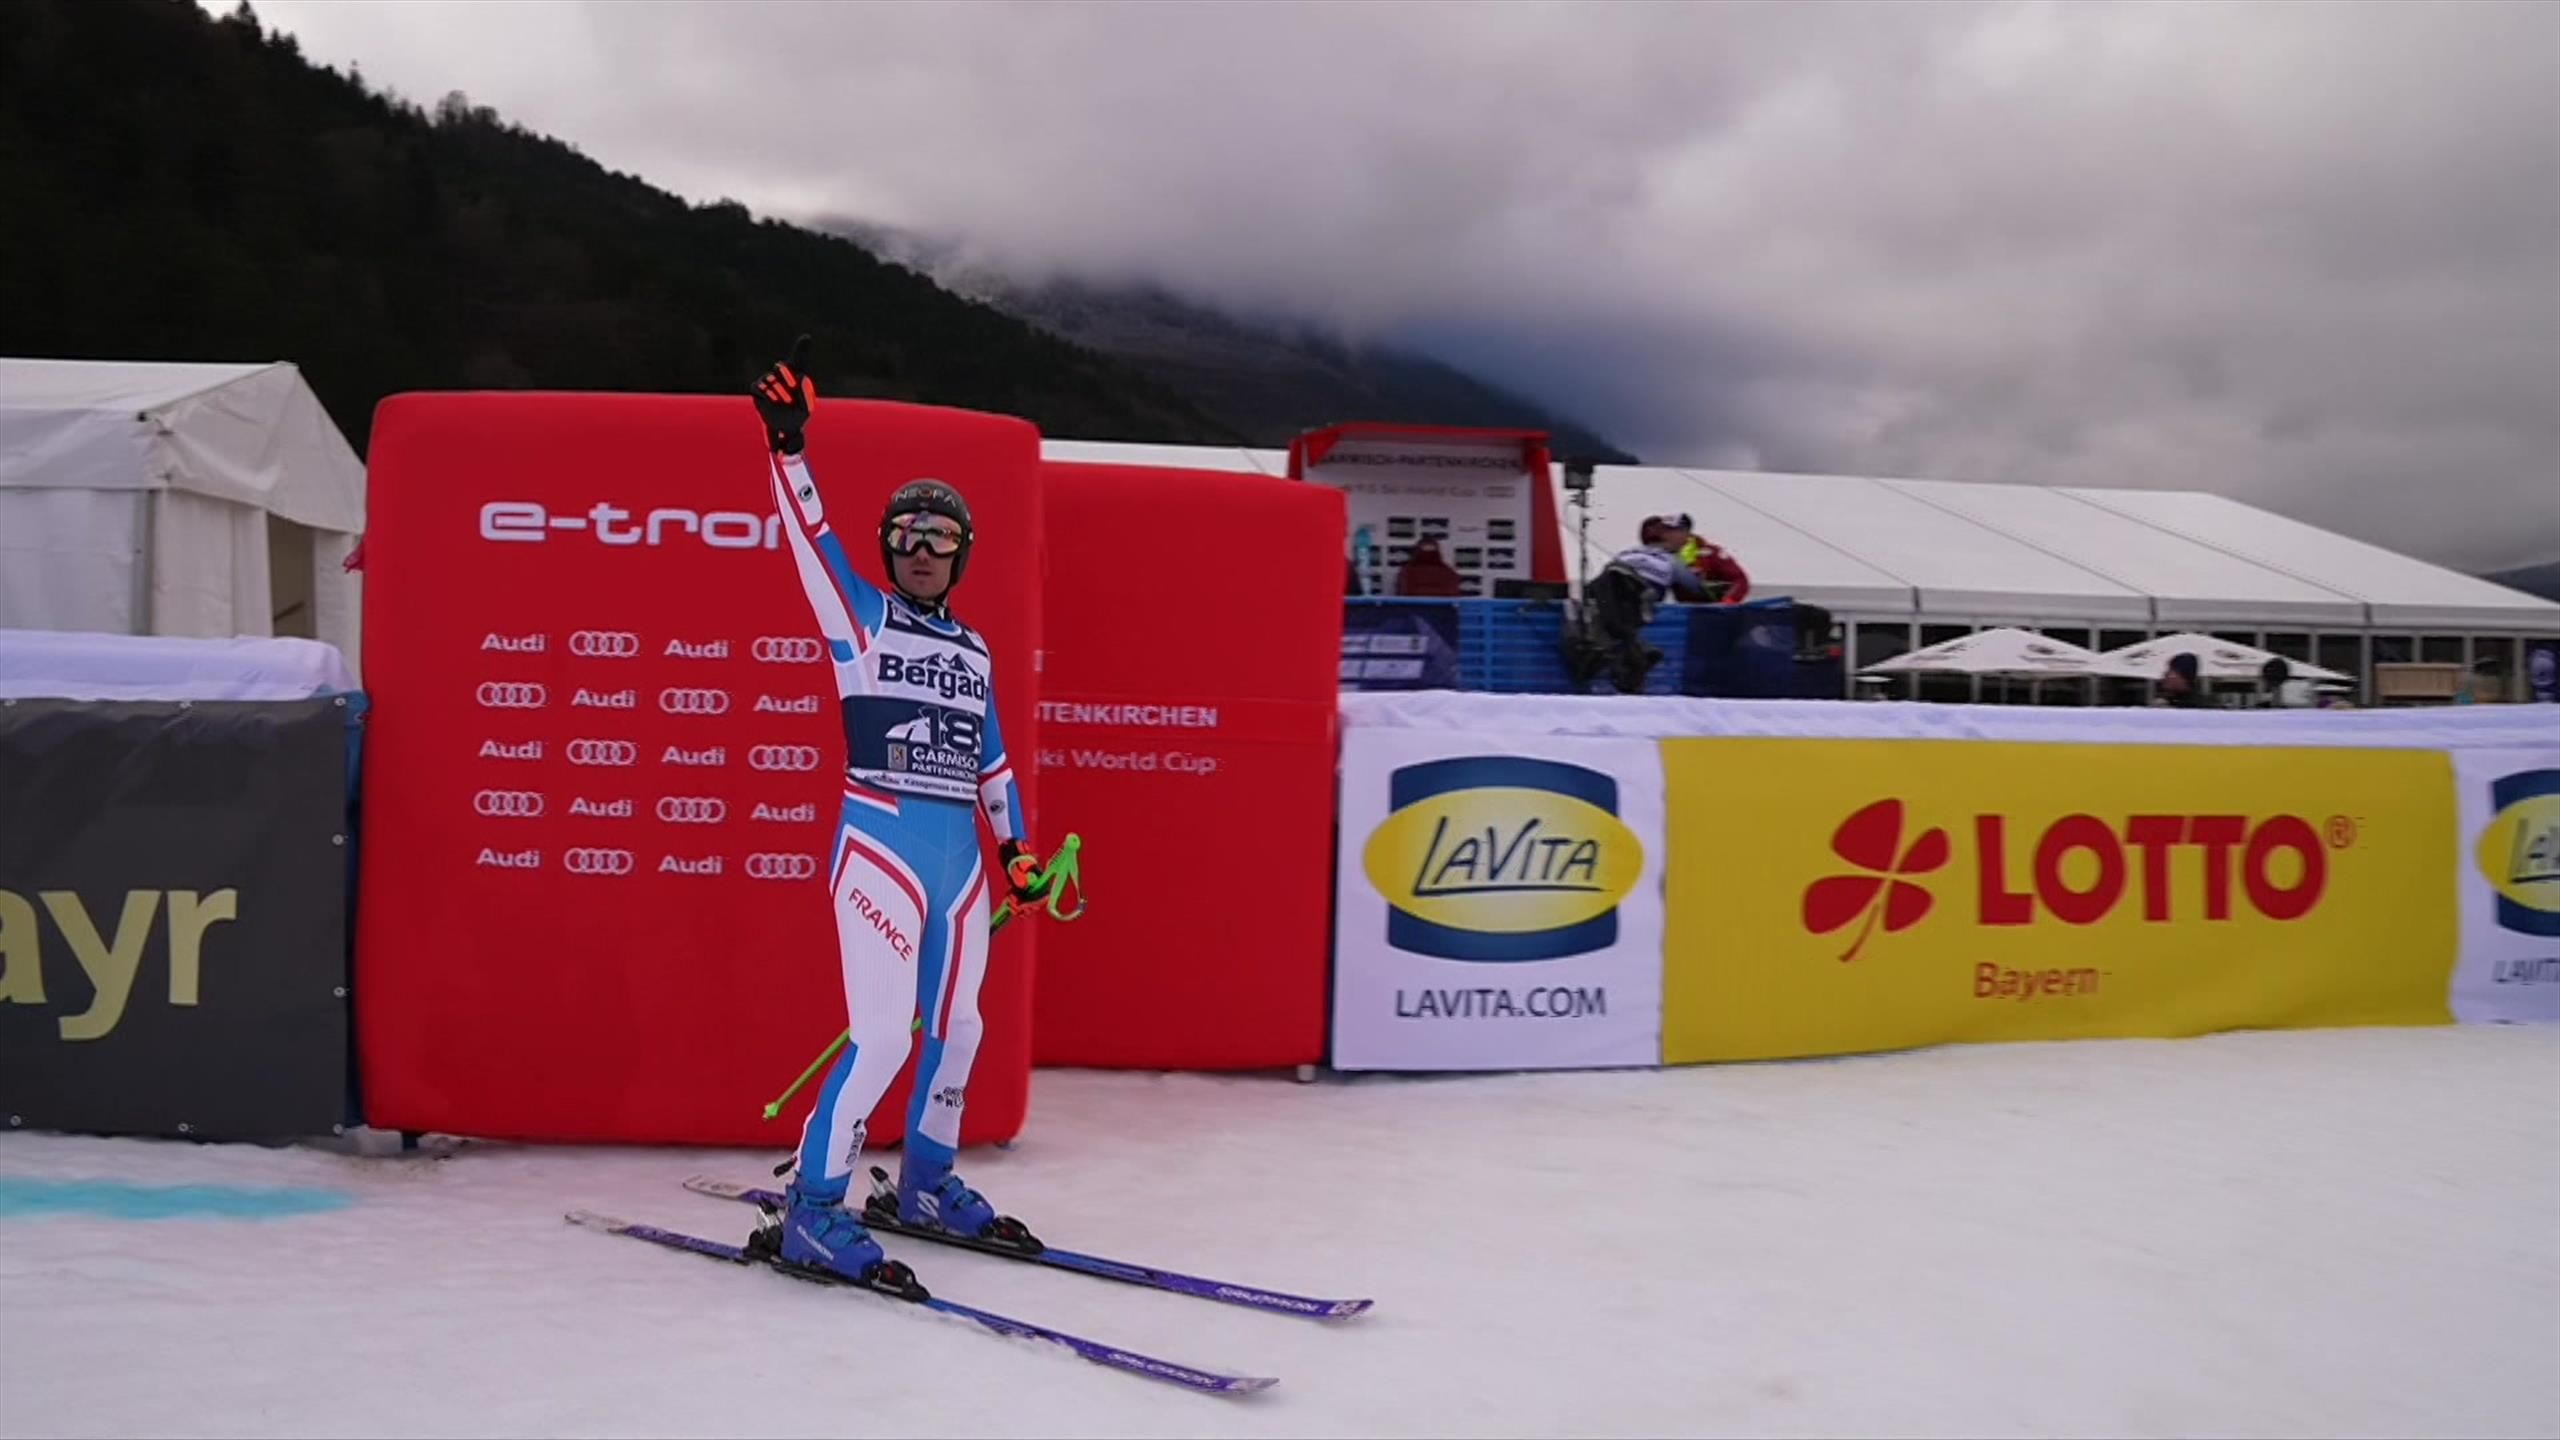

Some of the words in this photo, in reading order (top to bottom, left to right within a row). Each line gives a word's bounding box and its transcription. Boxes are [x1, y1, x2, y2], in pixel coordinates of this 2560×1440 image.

[481, 633, 545, 652] Audi
[664, 639, 728, 658] Audi
[571, 689, 635, 708] Audi
[753, 695, 818, 714] Audi
[1035, 701, 1217, 728] TENKIRCHEN
[918, 705, 980, 757] 18
[478, 740, 542, 760] Audi
[661, 746, 725, 766] Audi
[1071, 750, 1156, 771] World
[1164, 752, 1216, 776] Cup
[568, 797, 632, 817] Audi
[751, 803, 815, 822] Audi
[476, 848, 540, 868] Audi
[658, 855, 723, 875] Audi
[848, 888, 914, 962] FRANCE
[1973, 962, 2099, 1001] Bayern
[1395, 986, 1606, 1018] LAVITA.COM
